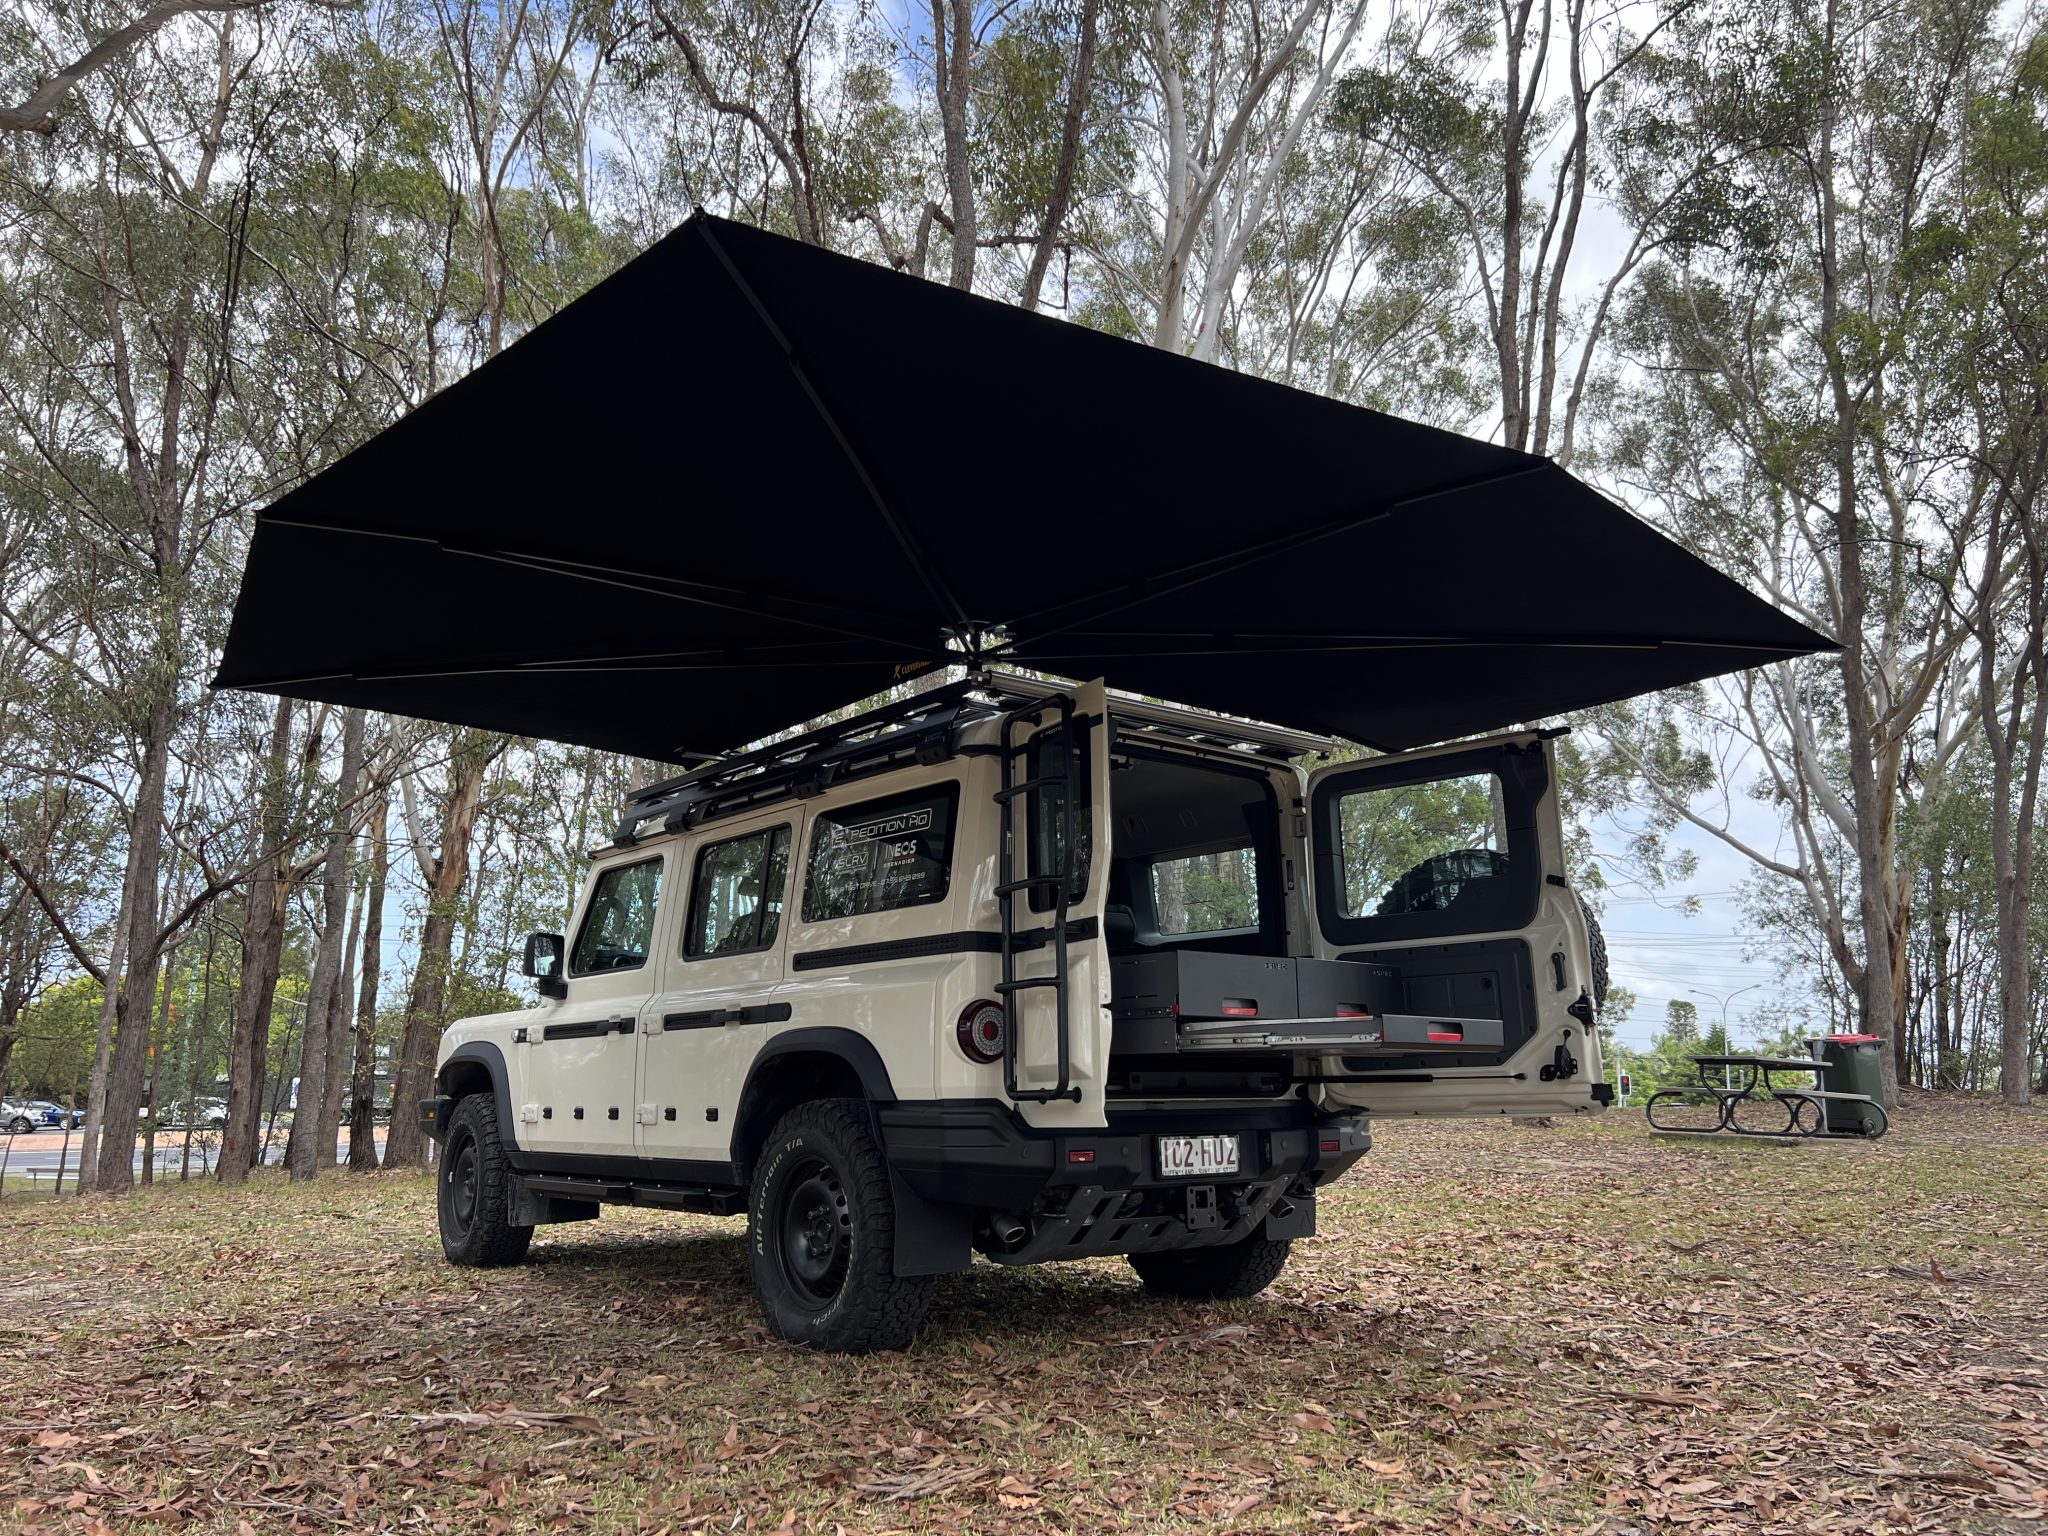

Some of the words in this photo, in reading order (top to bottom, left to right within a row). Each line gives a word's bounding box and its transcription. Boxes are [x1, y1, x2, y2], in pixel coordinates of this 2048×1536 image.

[909, 814, 928, 828] HQ
[885, 839, 917, 859] INEOS
[838, 854, 867, 868] SLRV
[884, 858, 915, 868] GRENADIER
[757, 1153, 783, 1256] All-Terrain
[785, 1138, 804, 1152] T/A
